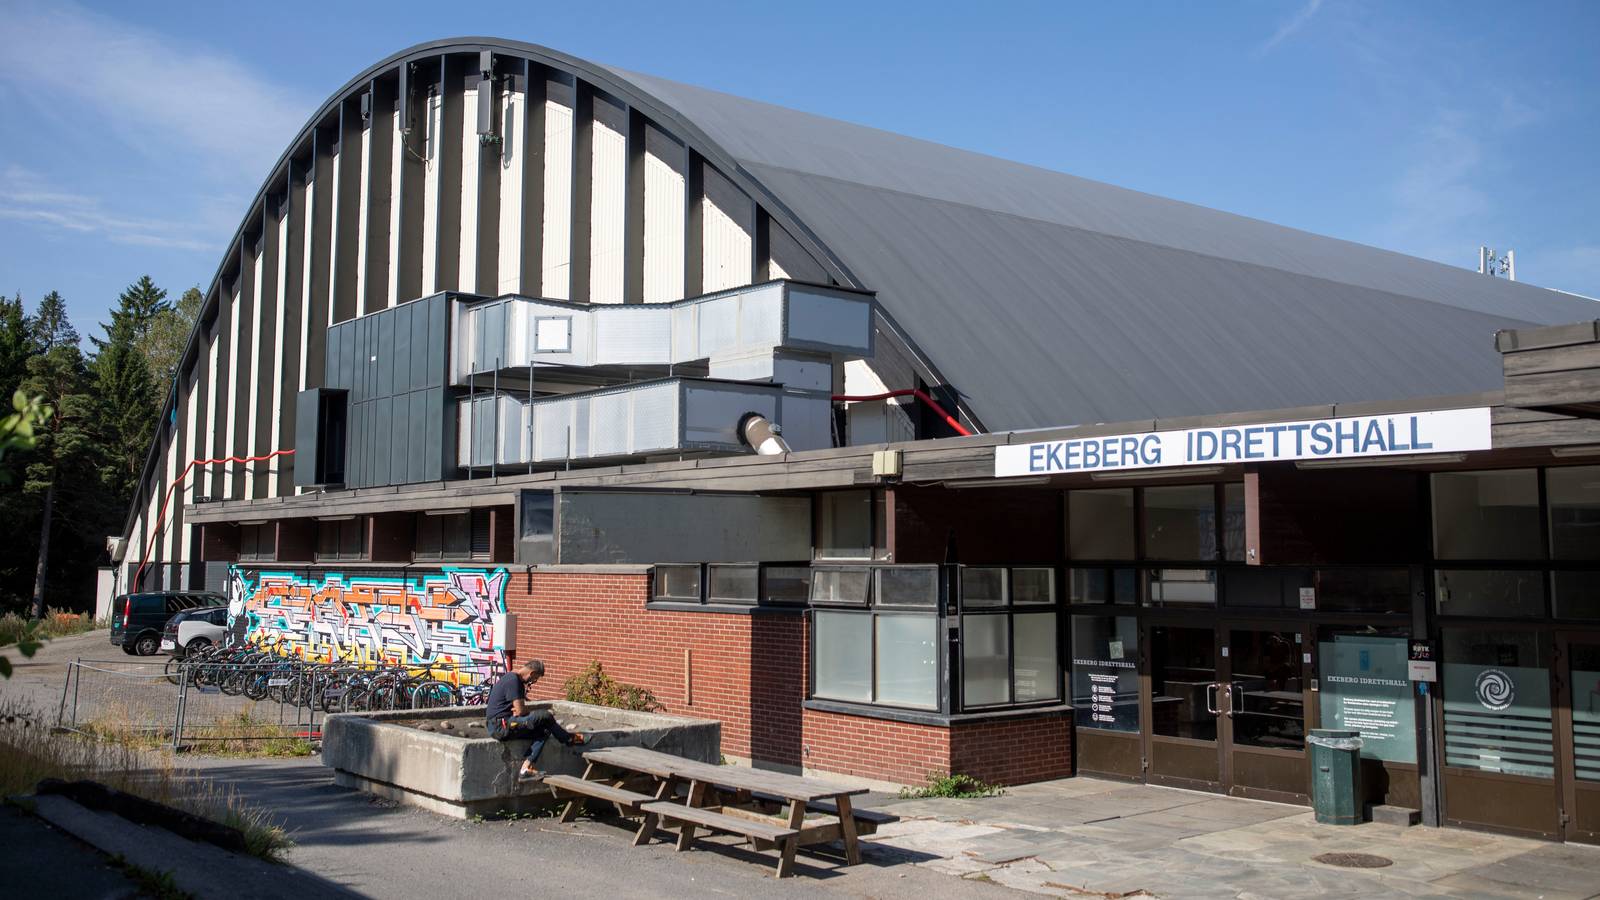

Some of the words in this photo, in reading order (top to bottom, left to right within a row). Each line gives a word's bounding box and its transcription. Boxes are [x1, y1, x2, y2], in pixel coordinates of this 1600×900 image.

[1029, 434, 1161, 472] EKEBERG
[1187, 416, 1433, 462] IDRETTSHALL
[1328, 676, 1358, 684] EKEBERG
[1360, 677, 1407, 686] IDRETTSHALL
